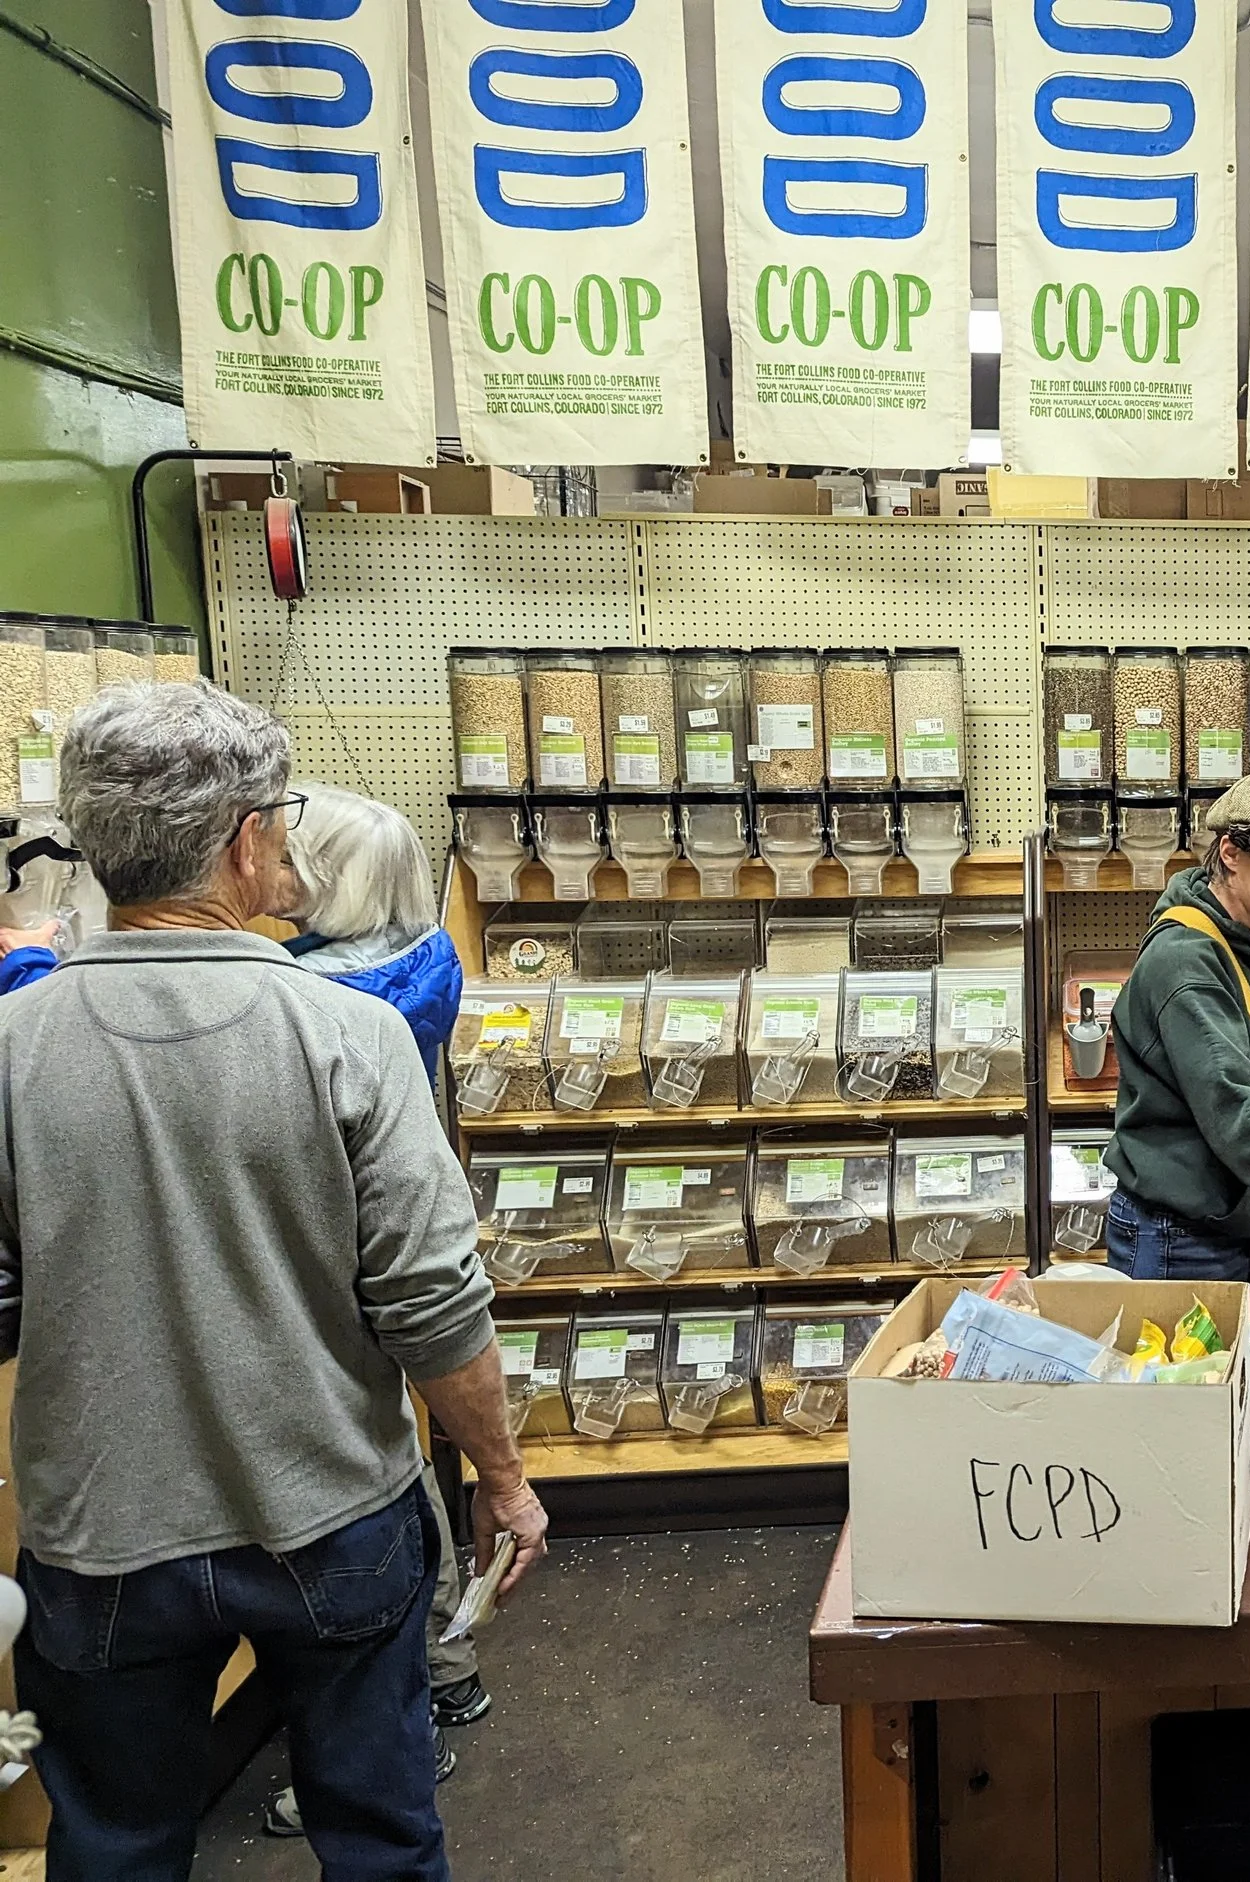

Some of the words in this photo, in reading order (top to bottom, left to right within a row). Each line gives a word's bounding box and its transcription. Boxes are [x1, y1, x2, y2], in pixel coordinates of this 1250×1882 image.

[215, 252, 384, 341] CO-OP
[478, 272, 662, 356] CO-OP
[755, 264, 931, 352] CO-OP
[1031, 282, 1200, 364] CO-OP
[216, 351, 234, 363] THE
[238, 353, 260, 366] FORT
[262, 356, 291, 367] COLLINS
[293, 357, 313, 368] FOOD
[316, 359, 381, 372] CO-OPERATIVE
[484, 374, 500, 385] THE
[502, 374, 524, 385] FORT
[527, 374, 564, 386] COLLINS
[568, 374, 591, 386] FOOD
[594, 375, 660, 387] CO-OPERATIVE
[756, 364, 772, 375] THE
[774, 364, 795, 376] FORT
[799, 365, 835, 378] COLLINS
[838, 367, 860, 379] FOOD
[863, 369, 925, 383] CO-OPERATIVE
[1031, 379, 1047, 391] THE
[1050, 380, 1070, 391] FORT
[1073, 381, 1107, 392] COLLINS
[1110, 381, 1131, 392] FOOD
[1134, 382, 1192, 395] CO-OPERATIVE
[487, 402, 509, 413] FORT
[511, 402, 553, 414] COLLINS,
[555, 402, 605, 414] COLORADO
[611, 403, 639, 414] SINCE
[642, 404, 663, 414] 1972
[758, 392, 778, 403] FORT
[781, 393, 821, 405] COLLINS,
[823, 394, 872, 407] COLORADO
[877, 397, 903, 408] SINCE
[907, 399, 926, 409] 1972
[1030, 406, 1052, 417] FORT
[1055, 407, 1094, 419] COLLINS,
[1095, 408, 1142, 419] COLORADO
[1147, 409, 1171, 420] SINCE
[1174, 410, 1193, 420] 1972
[958, 482, 988, 494] ANIC
[970, 1458, 1121, 1550] FCPD
